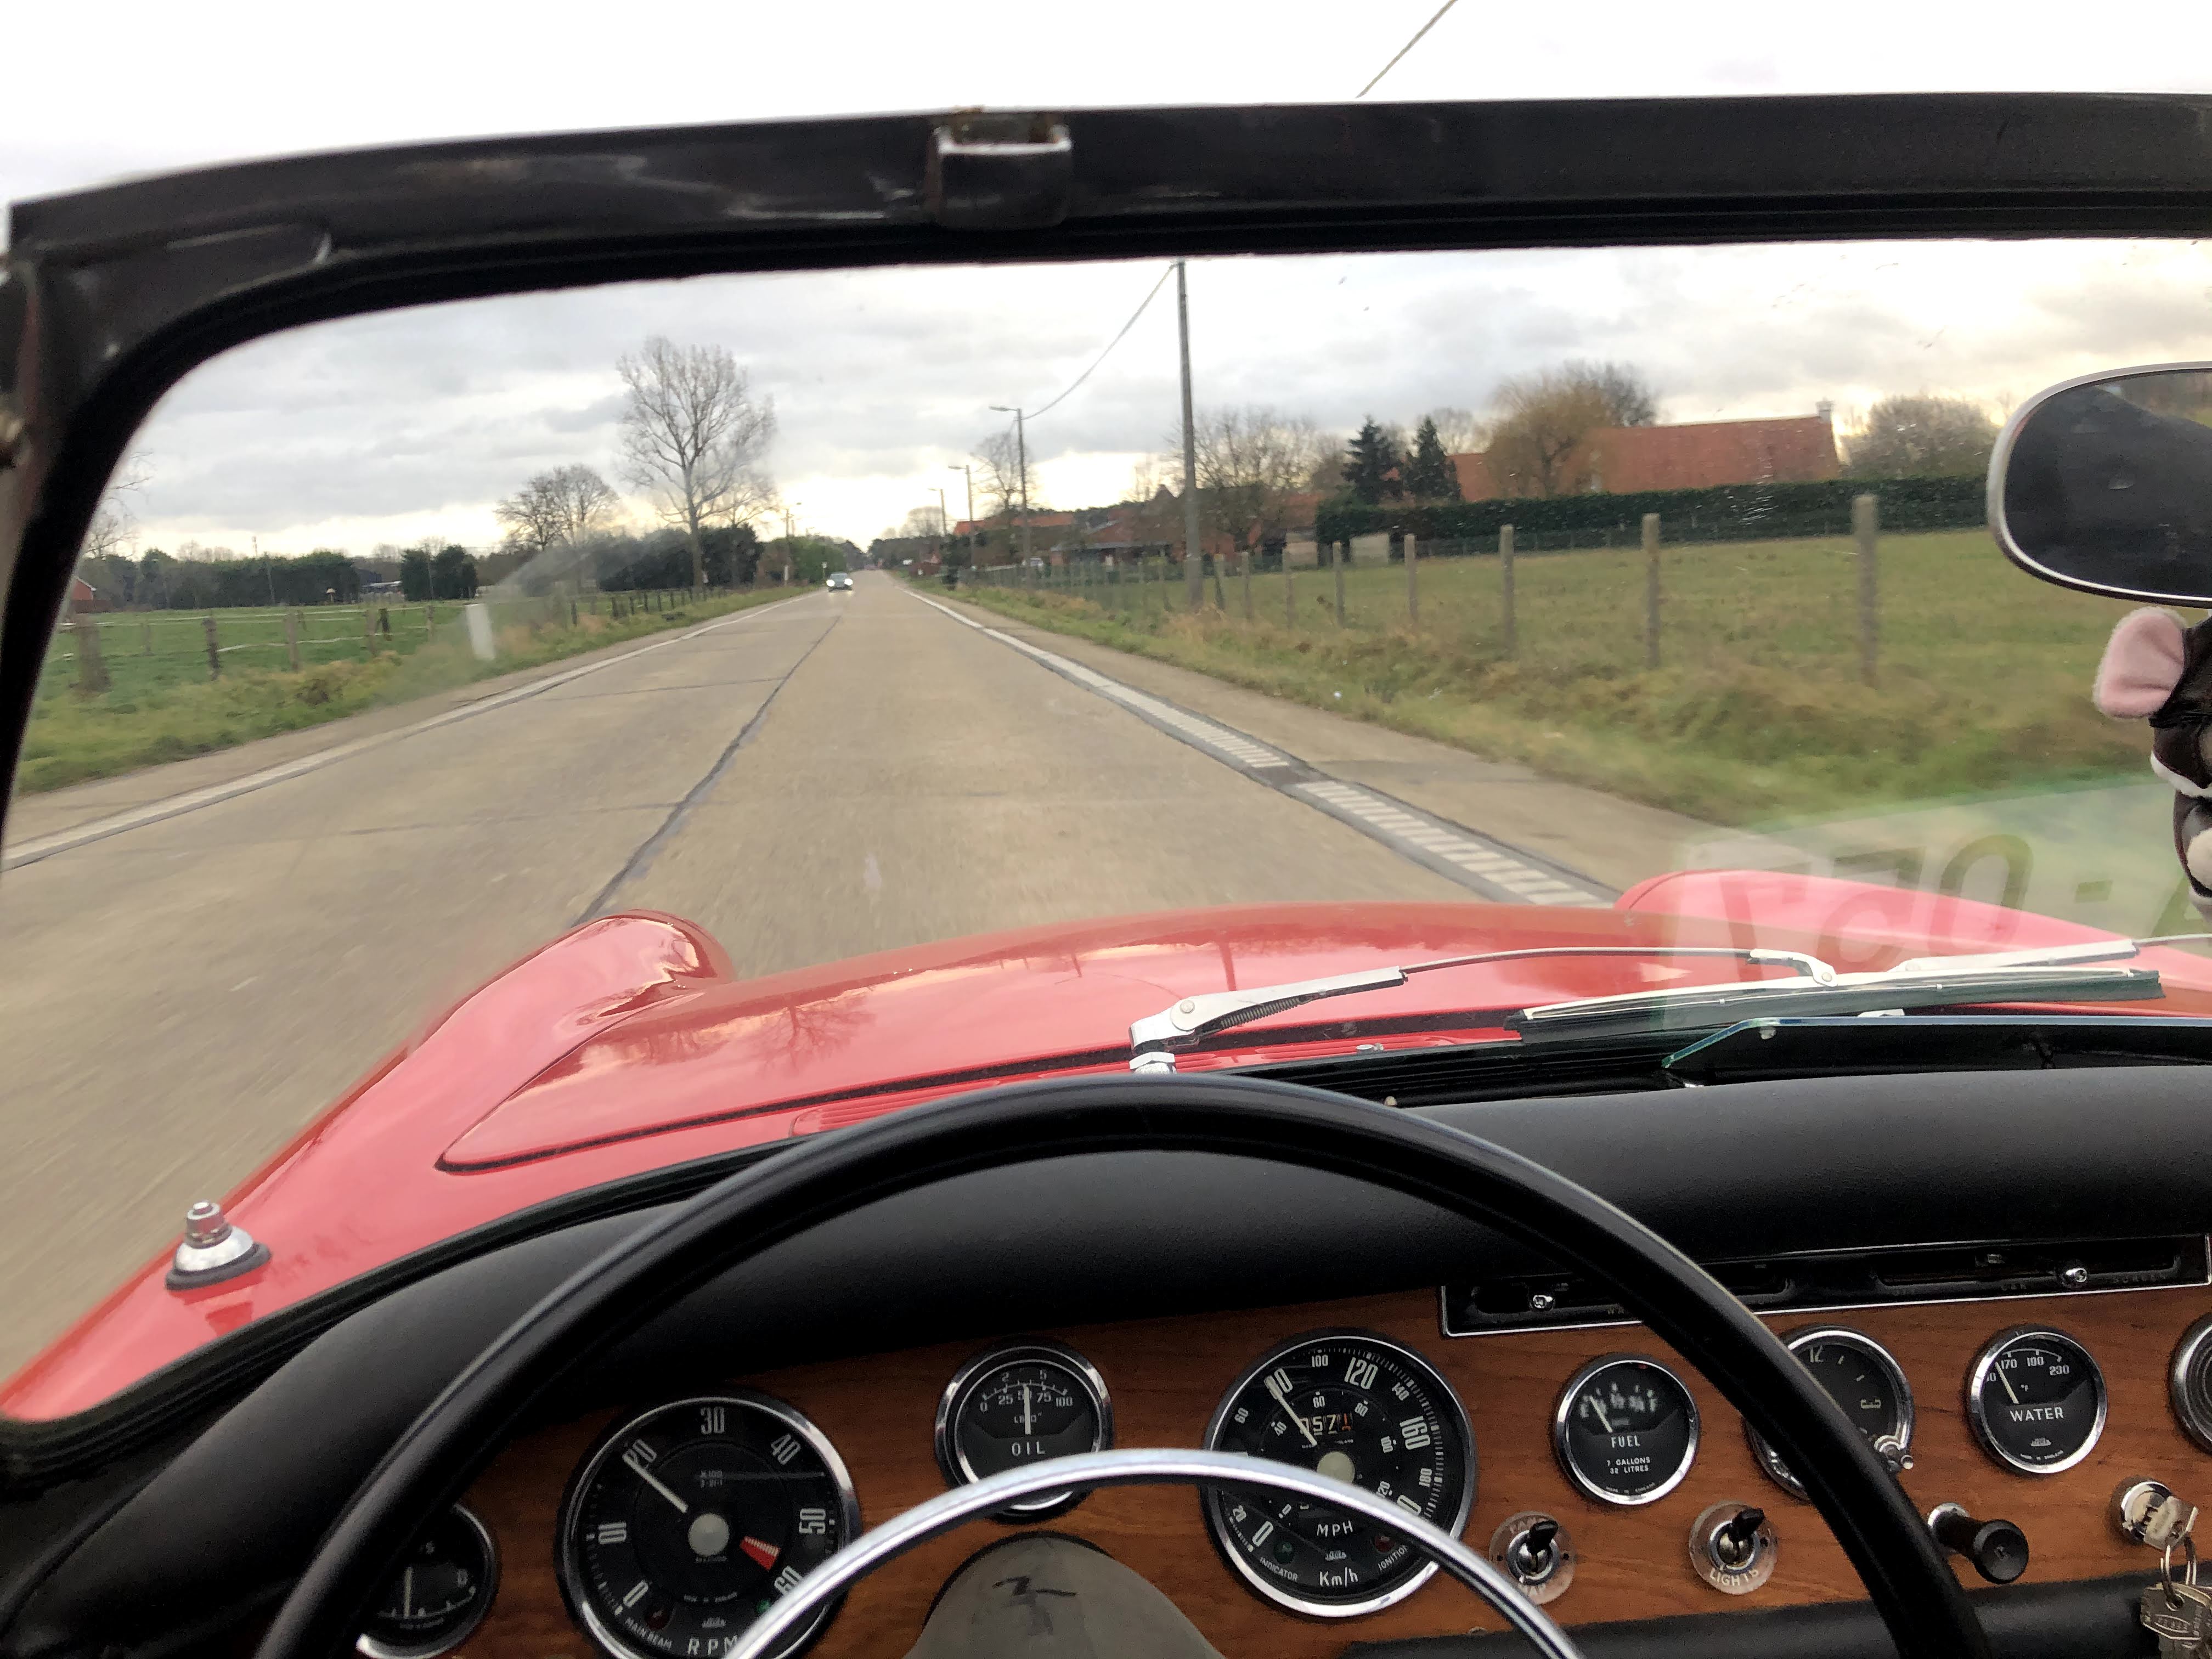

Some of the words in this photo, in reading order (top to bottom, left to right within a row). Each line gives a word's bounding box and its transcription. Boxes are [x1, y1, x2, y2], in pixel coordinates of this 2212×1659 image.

[1311, 1355, 1328, 1367] 100
[2001, 1358, 2018, 1369] 170
[1344, 1357, 1379, 1390] 120
[2049, 1364, 2070, 1376] 230
[1392, 1382, 1410, 1401] 140
[1313, 1396, 1325, 1408] 60
[1355, 1402, 1368, 1417] 80
[700, 1408, 725, 1434] 30
[1234, 1407, 1249, 1424] 60
[2010, 1406, 2064, 1422] WATER
[1274, 1421, 1287, 1436] 40
[1400, 1415, 1431, 1450] 160
[770, 1434, 801, 1465] 40
[1012, 1441, 1045, 1457] OIL
[1381, 1436, 1393, 1453] 100
[1611, 1435, 1640, 1448] FUEL
[1616, 1456, 1650, 1466] GALLONS
[1624, 1465, 1649, 1474] LITRES
[1418, 1468, 1432, 1487] 180
[1376, 1481, 1390, 1498] 120
[1233, 1505, 1247, 1522] 20
[1282, 1504, 1291, 1515] 0
[799, 1508, 826, 1534] 50
[1317, 1520, 1353, 1537] MPH
[598, 1522, 627, 1544] 10
[1252, 1521, 1274, 1547] 0
[1260, 1557, 1299, 1582] INDICATOR
[1319, 1566, 1358, 1587] Km/h
[1709, 1567, 1759, 1587] LIGHTS
[623, 1580, 649, 1607] 0
